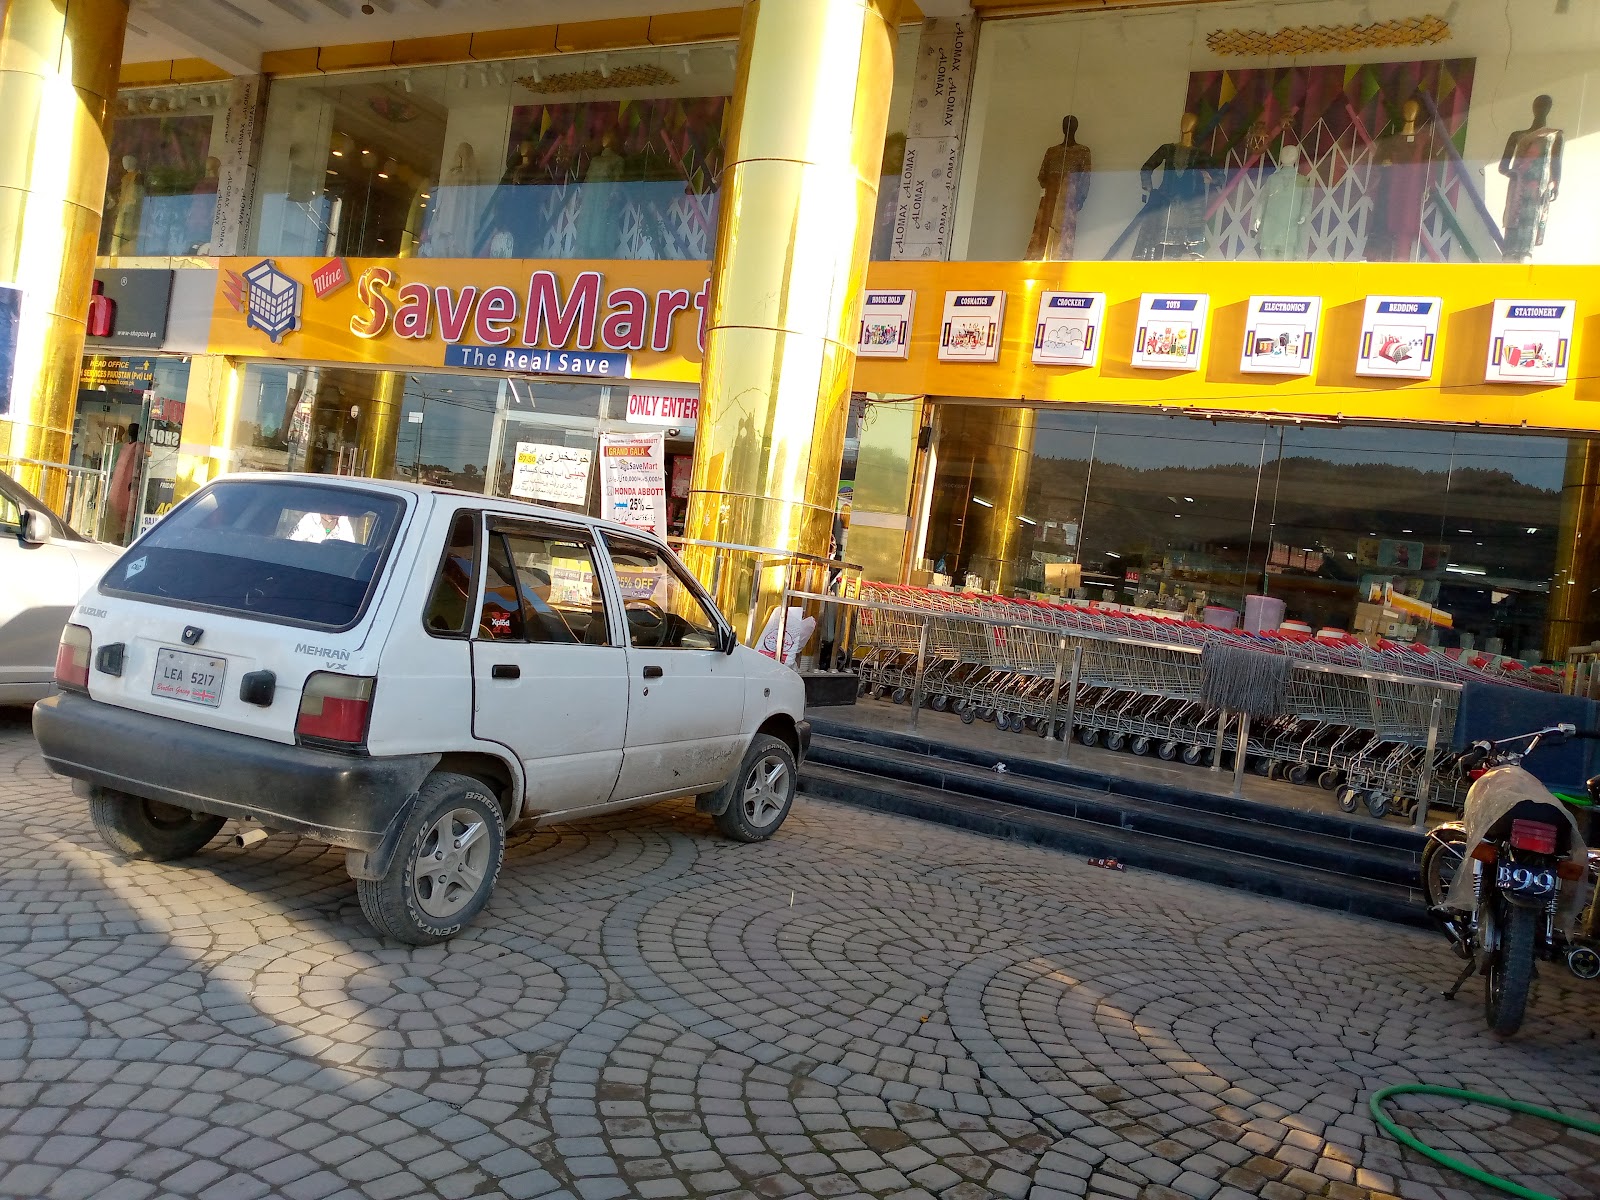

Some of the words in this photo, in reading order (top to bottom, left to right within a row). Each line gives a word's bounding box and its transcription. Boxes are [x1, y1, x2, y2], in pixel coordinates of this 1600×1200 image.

[313, 268, 342, 294] Mine
[871, 296, 887, 304] HOUSE
[1057, 298, 1086, 307] CROCKERY
[1166, 300, 1180, 309] TOYS
[1264, 302, 1306, 312] ELECTRONICS
[1388, 303, 1418, 313] BEDDING
[1514, 306, 1557, 318] STATIONERY
[108, 361, 129, 369] OFFICE
[462, 348, 496, 368] The
[504, 350, 551, 372] Real
[559, 353, 610, 374] Save
[107, 370, 131, 379] PAKISTAN
[144, 372, 153, 380] Ltd
[630, 395, 659, 416] ONLY
[608, 447, 628, 455] GRAND
[630, 448, 645, 456] GALA
[629, 462, 658, 470] SaveMart
[614, 487, 636, 496] HONDA
[637, 488, 664, 496] ABBOTT
[629, 498, 645, 511] 25%
[634, 577, 653, 589] OFF
[79, 605, 108, 618] SUZUKI
[294, 643, 350, 661] MEHRAN
[326, 662, 347, 671] VX
[164, 667, 183, 681] LEA
[191, 672, 215, 686] 5217
